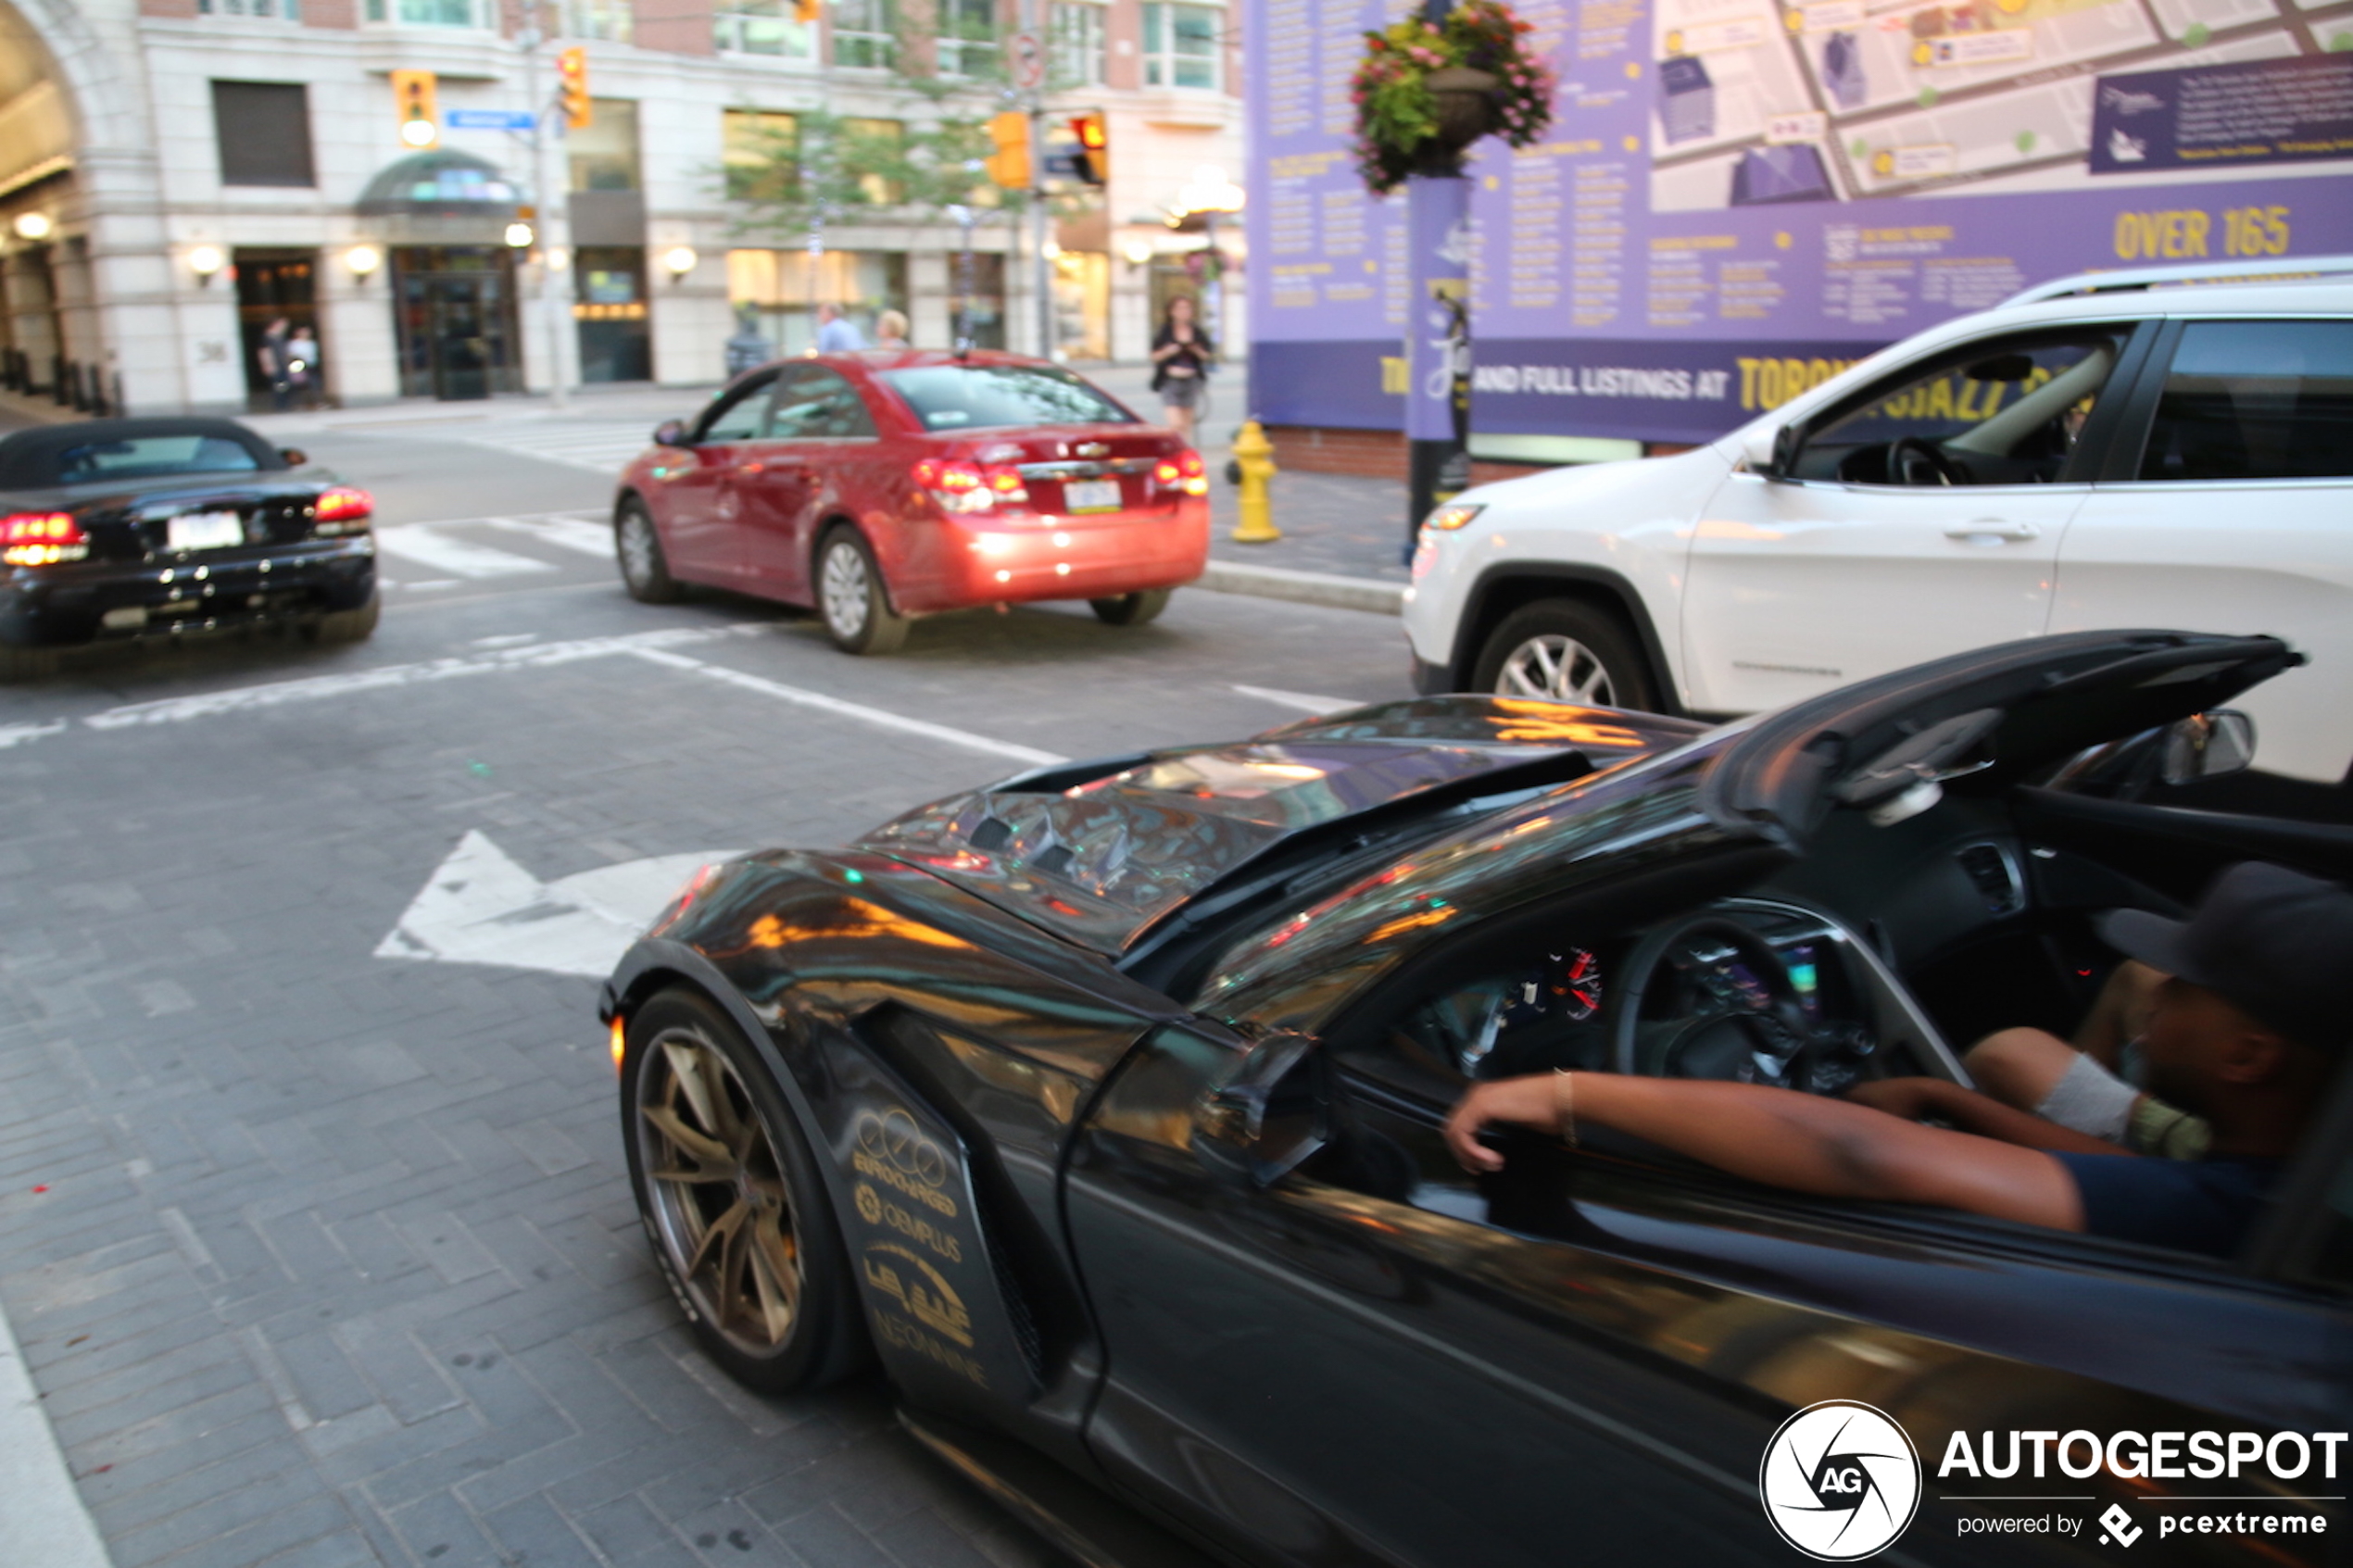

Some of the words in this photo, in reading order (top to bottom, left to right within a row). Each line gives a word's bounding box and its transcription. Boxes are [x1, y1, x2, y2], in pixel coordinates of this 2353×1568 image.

[2113, 208, 2210, 259] OVER
[2222, 206, 2290, 256] 165
[1474, 365, 1519, 393] AND
[1521, 365, 1579, 394] FULL
[1580, 367, 1692, 399] LISTINGS
[1696, 370, 1730, 400] AT
